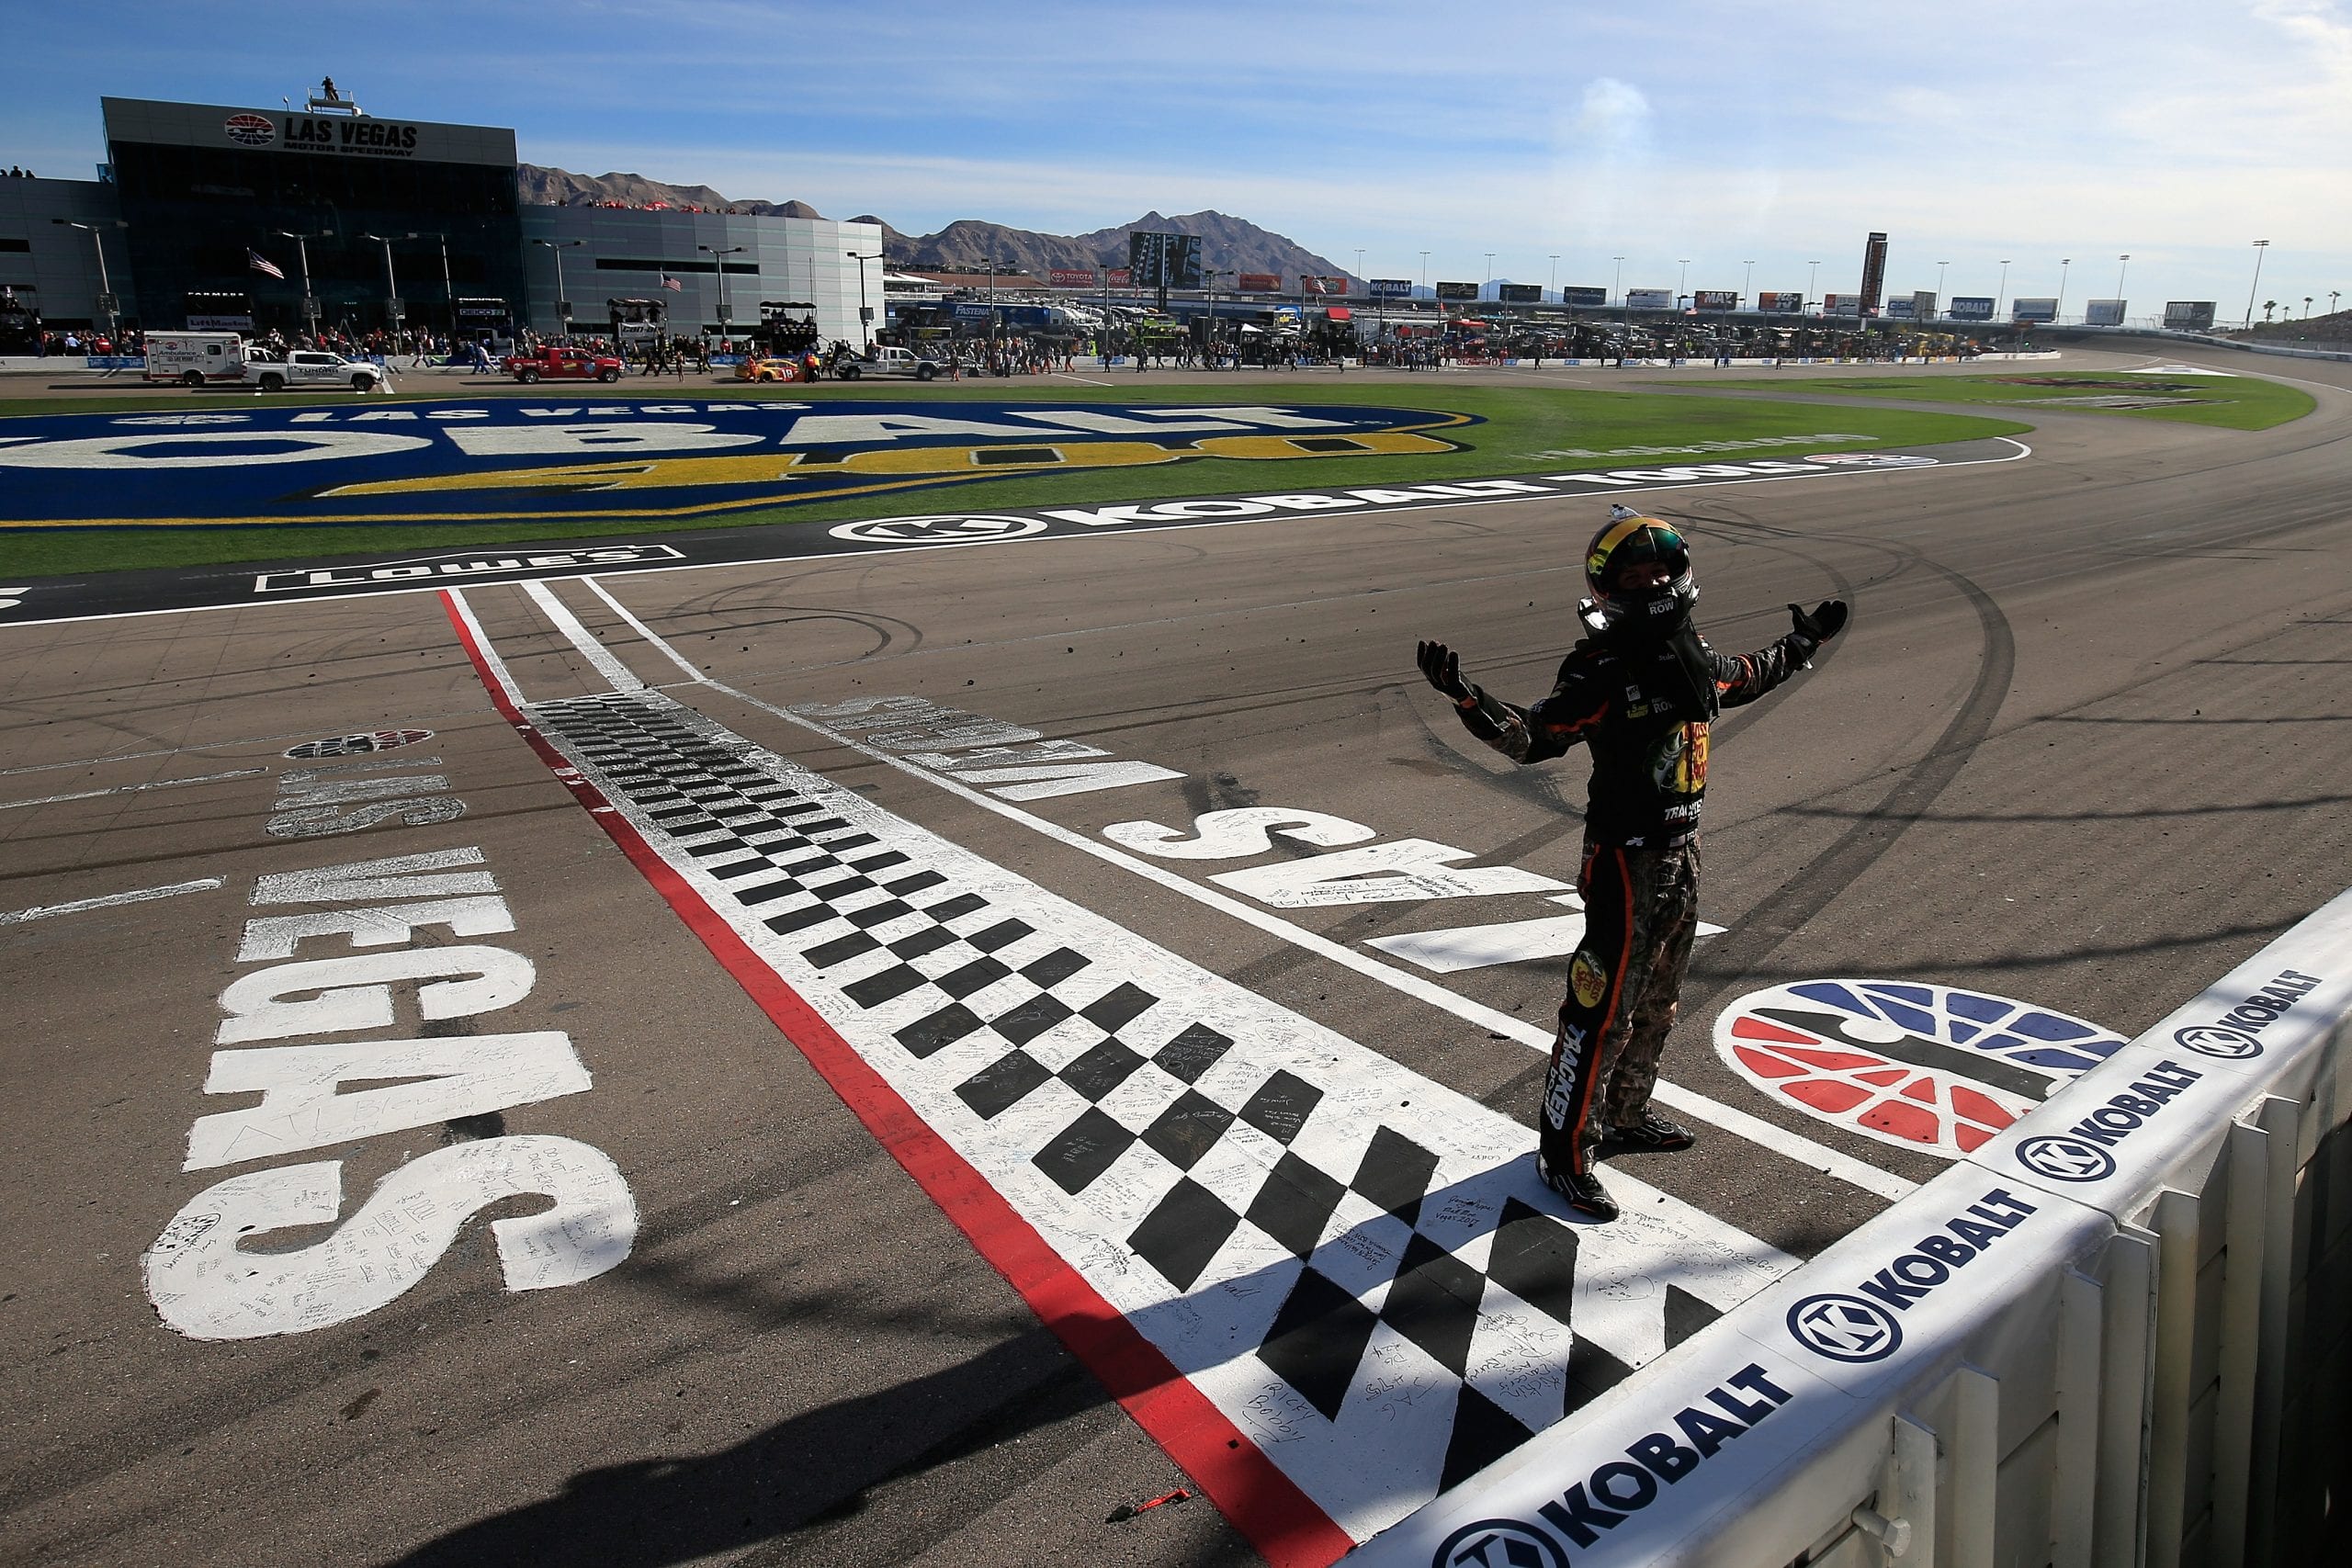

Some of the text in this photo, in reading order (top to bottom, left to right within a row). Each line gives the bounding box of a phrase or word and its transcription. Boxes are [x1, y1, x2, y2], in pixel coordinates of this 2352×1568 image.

[284, 141, 414, 157] MOTOR SPEEDWAY
[285, 117, 417, 149] LAS VEGAS
[1371, 282, 1411, 292] KOBALT
[1889, 300, 1915, 310] GEIC
[1952, 301, 1991, 313] KOBALT
[781, 367, 793, 378] 18
[288, 404, 814, 423] LAS VEGAS
[0, 407, 1359, 470] OBALT
[312, 432, 1458, 499] 400
[1038, 479, 1560, 526] KOBALT
[1542, 460, 1830, 486] TOOLS
[309, 549, 642, 584] LOWE'S
[1649, 603, 1675, 615] ROW
[785, 695, 1729, 976] LAS VEGAS
[2216, 970, 2324, 1034] KOBALT
[141, 845, 639, 1342] VEGAS
[2069, 1059, 2204, 1146] KOBALT
[1858, 1188, 2039, 1312] KOBALT
[1537, 1362, 1794, 1551] KOBALT
